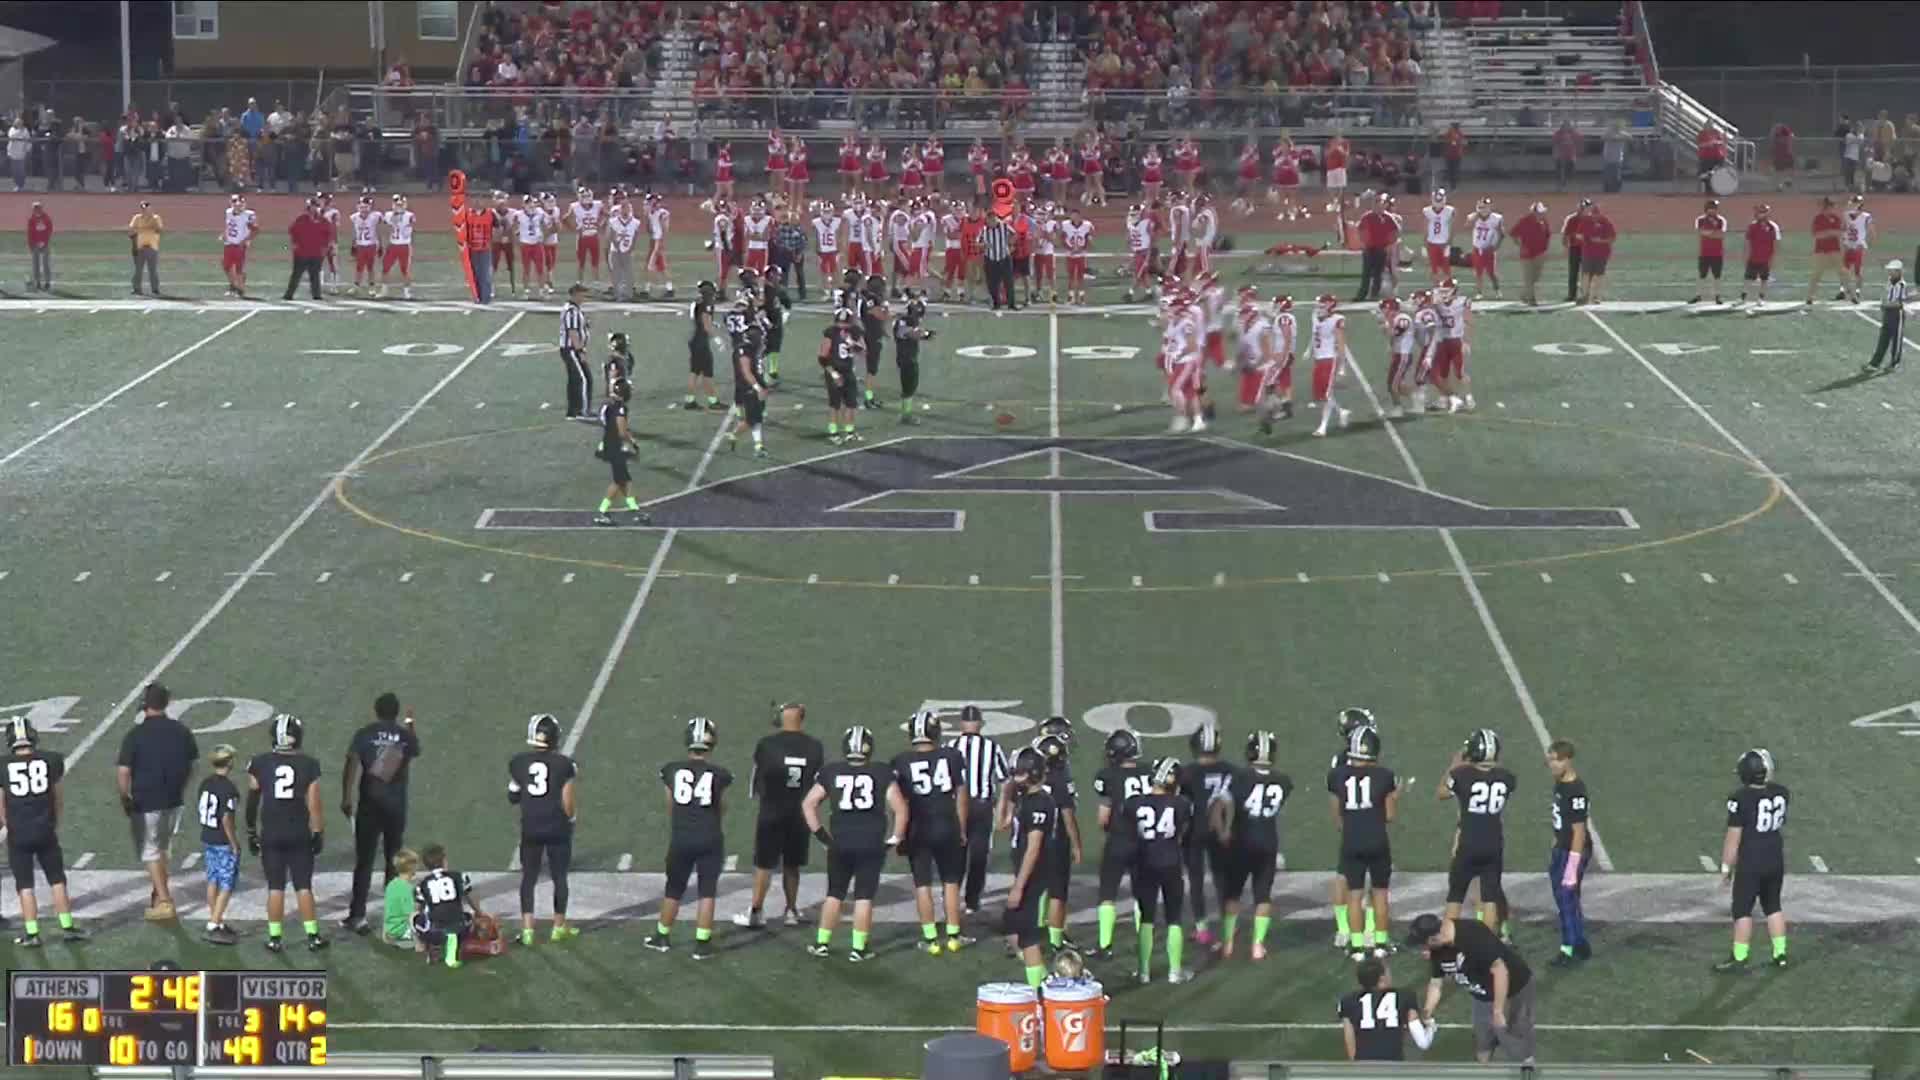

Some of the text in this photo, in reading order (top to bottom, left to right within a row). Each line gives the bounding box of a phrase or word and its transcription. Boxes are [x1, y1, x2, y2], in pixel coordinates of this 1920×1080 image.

[7, 759, 48, 797] 58
[274, 764, 294, 799] 2
[528, 763, 548, 796] 3
[673, 769, 714, 805] 64
[835, 775, 875, 811] 73
[911, 758, 951, 794] 54
[1345, 776, 1373, 810] 11
[199, 790, 219, 828] 42
[1244, 783, 1283, 817] 43
[1469, 782, 1506, 814] 26
[1756, 795, 1786, 832] 62
[1136, 806, 1176, 840] 24
[1064, 1012, 1083, 1033] G
[1359, 991, 1399, 1029] 14
